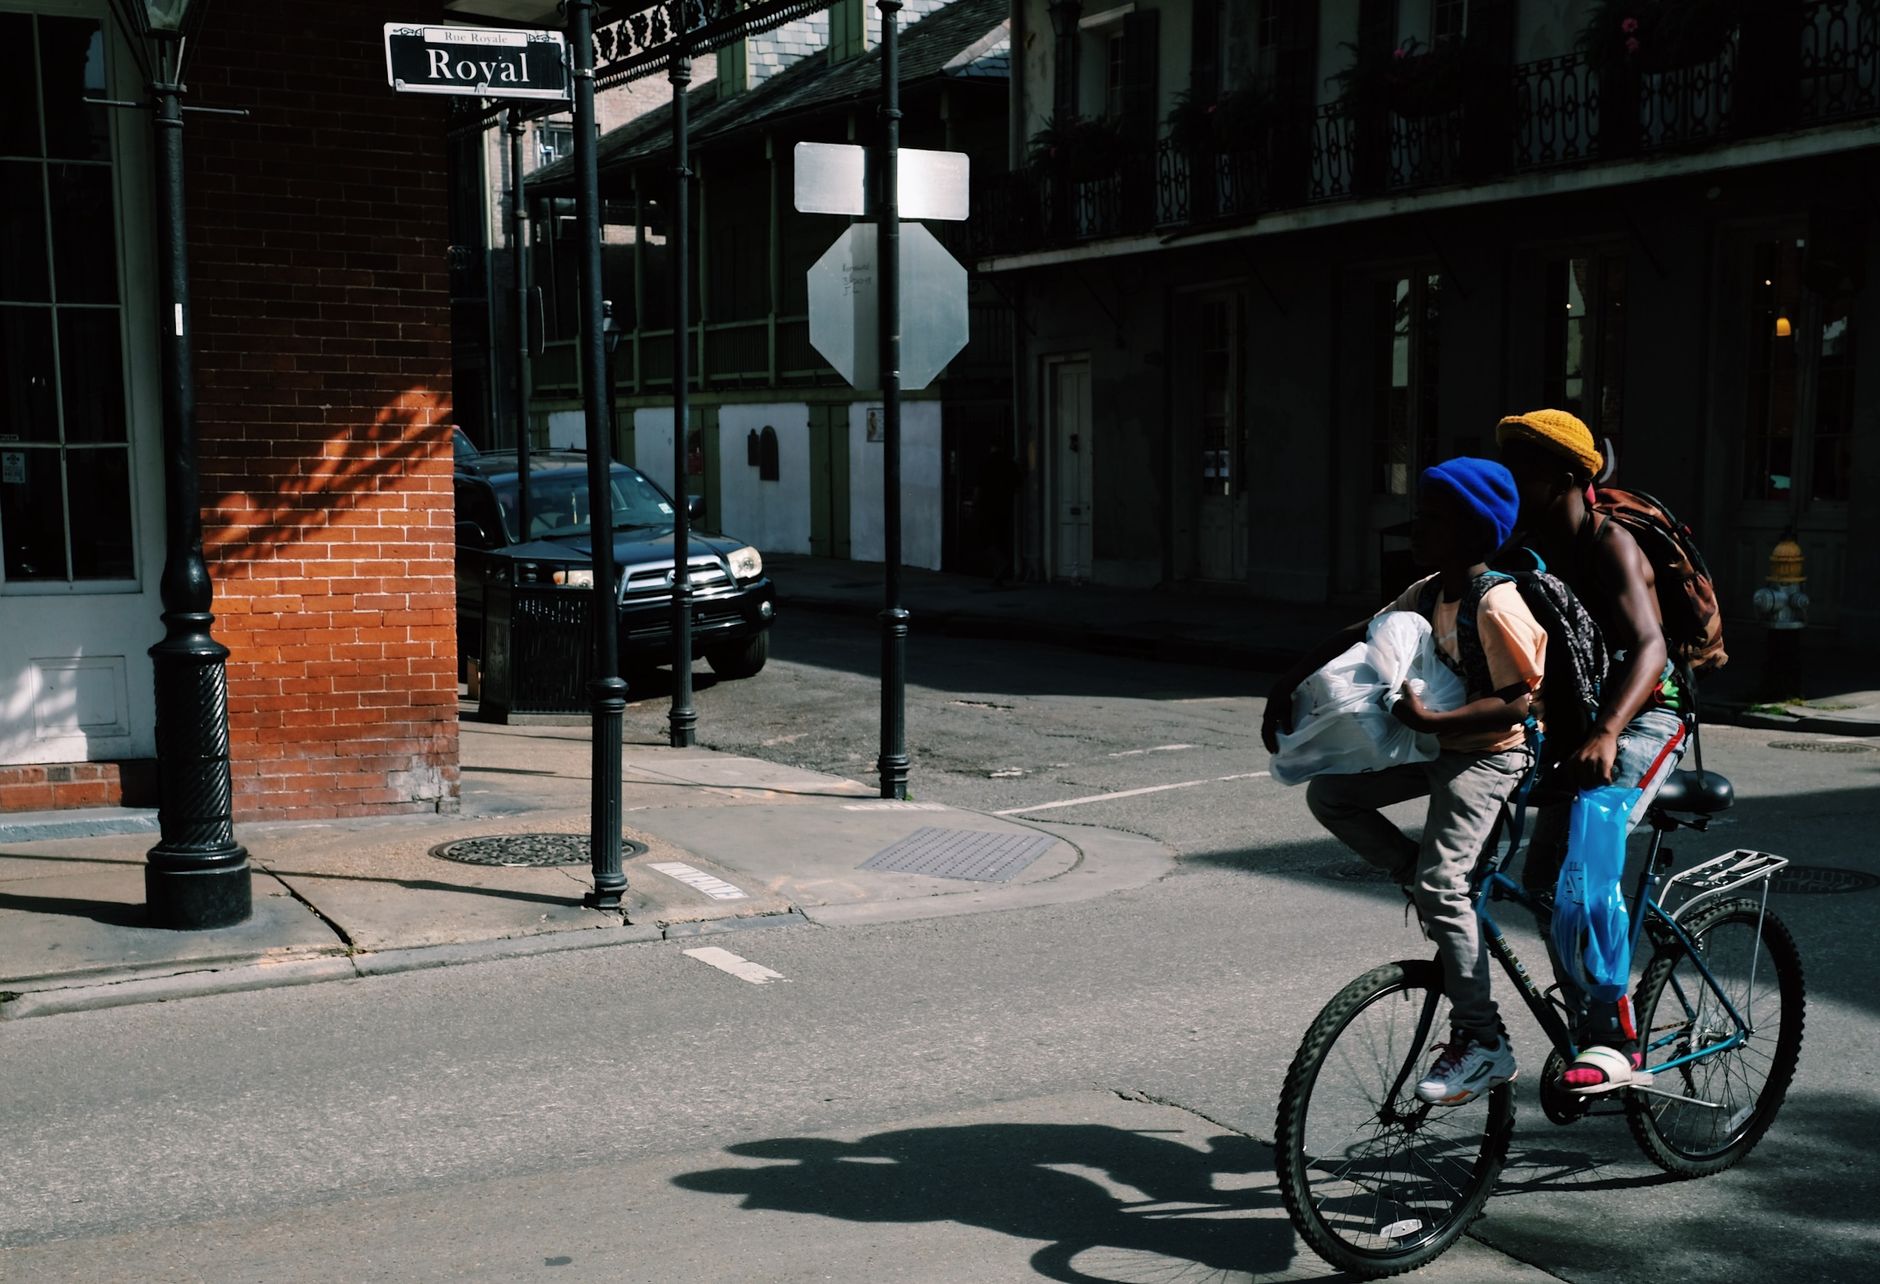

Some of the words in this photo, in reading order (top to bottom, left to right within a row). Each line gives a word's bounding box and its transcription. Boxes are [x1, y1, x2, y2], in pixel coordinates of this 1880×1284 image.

[446, 32, 467, 42] Rue
[472, 33, 507, 45] Royale
[427, 49, 530, 86] Royal
